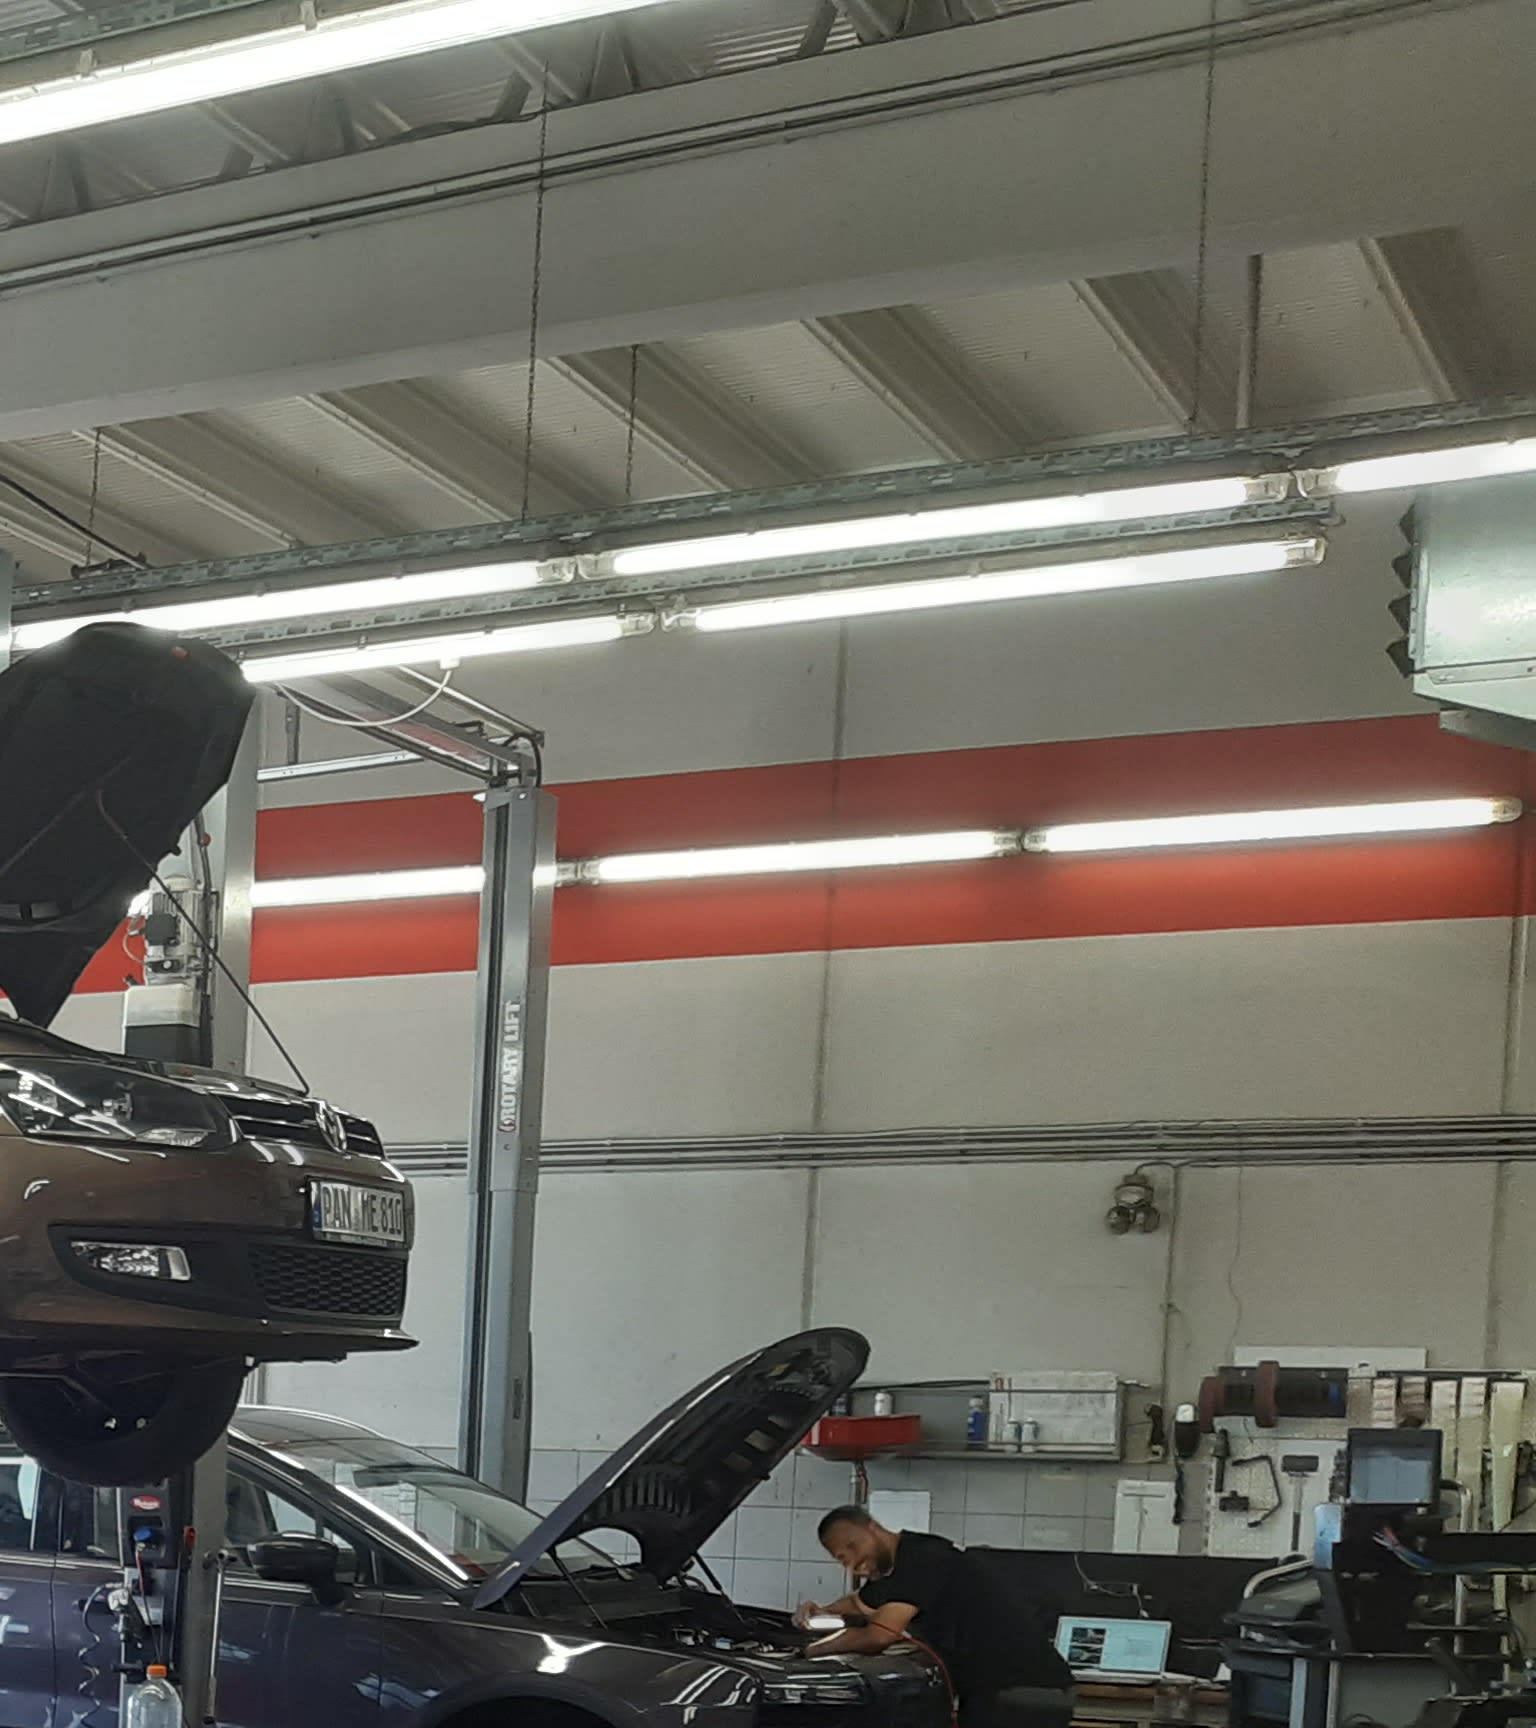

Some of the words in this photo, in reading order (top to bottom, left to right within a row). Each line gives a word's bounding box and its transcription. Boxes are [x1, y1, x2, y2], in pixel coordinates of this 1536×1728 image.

[503, 1000, 520, 1041] LIFT
[500, 1047, 518, 1122] ROTARY
[322, 1185, 352, 1229] PAN
